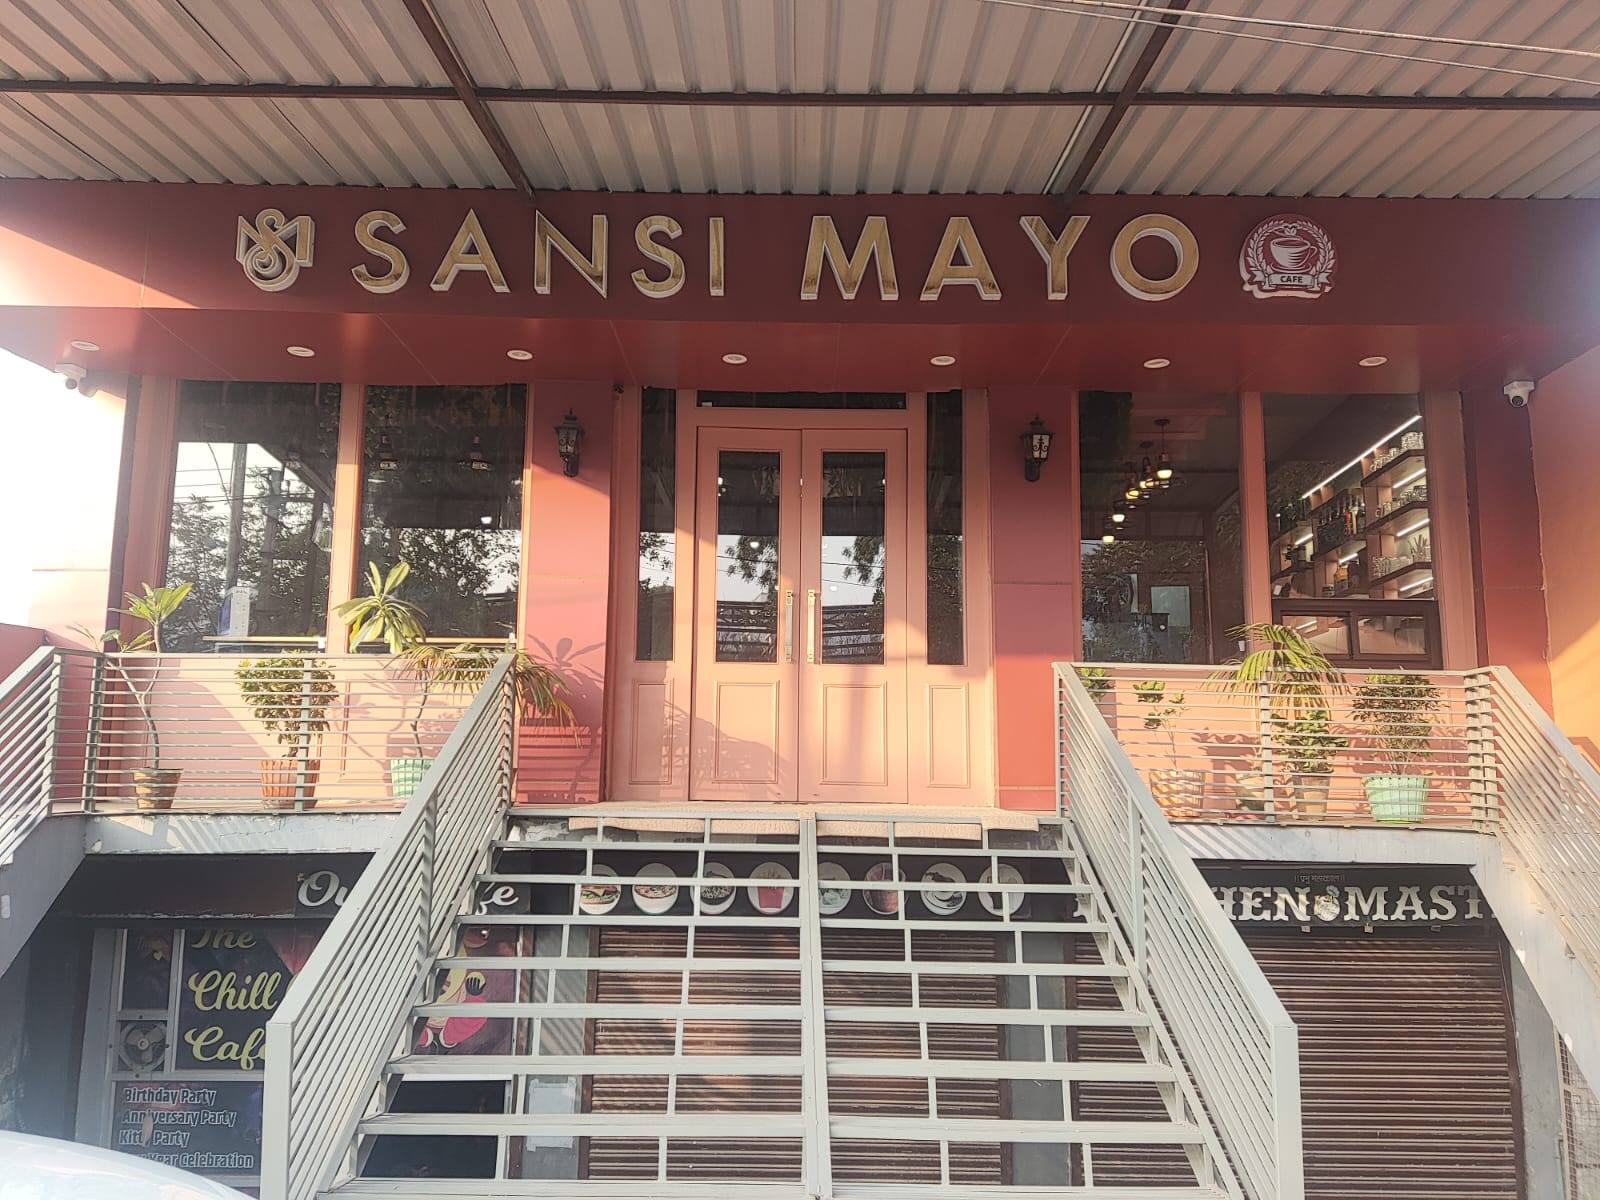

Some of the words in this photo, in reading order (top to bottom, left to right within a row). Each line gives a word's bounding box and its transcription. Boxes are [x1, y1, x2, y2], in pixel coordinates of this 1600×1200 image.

[351, 207, 724, 299] SANSI
[800, 213, 1200, 301] MAYO
[1279, 275, 1303, 284] CAFE
[1343, 885, 1497, 921] MAST
[188, 969, 282, 1011] Chill
[124, 1087, 179, 1106] Birthday
[180, 1088, 216, 1106] Party
[200, 1110, 237, 1127] Party
[119, 1129, 151, 1147] Kitt
[153, 1130, 190, 1148] Party
[180, 1152, 254, 1169] Celebration
